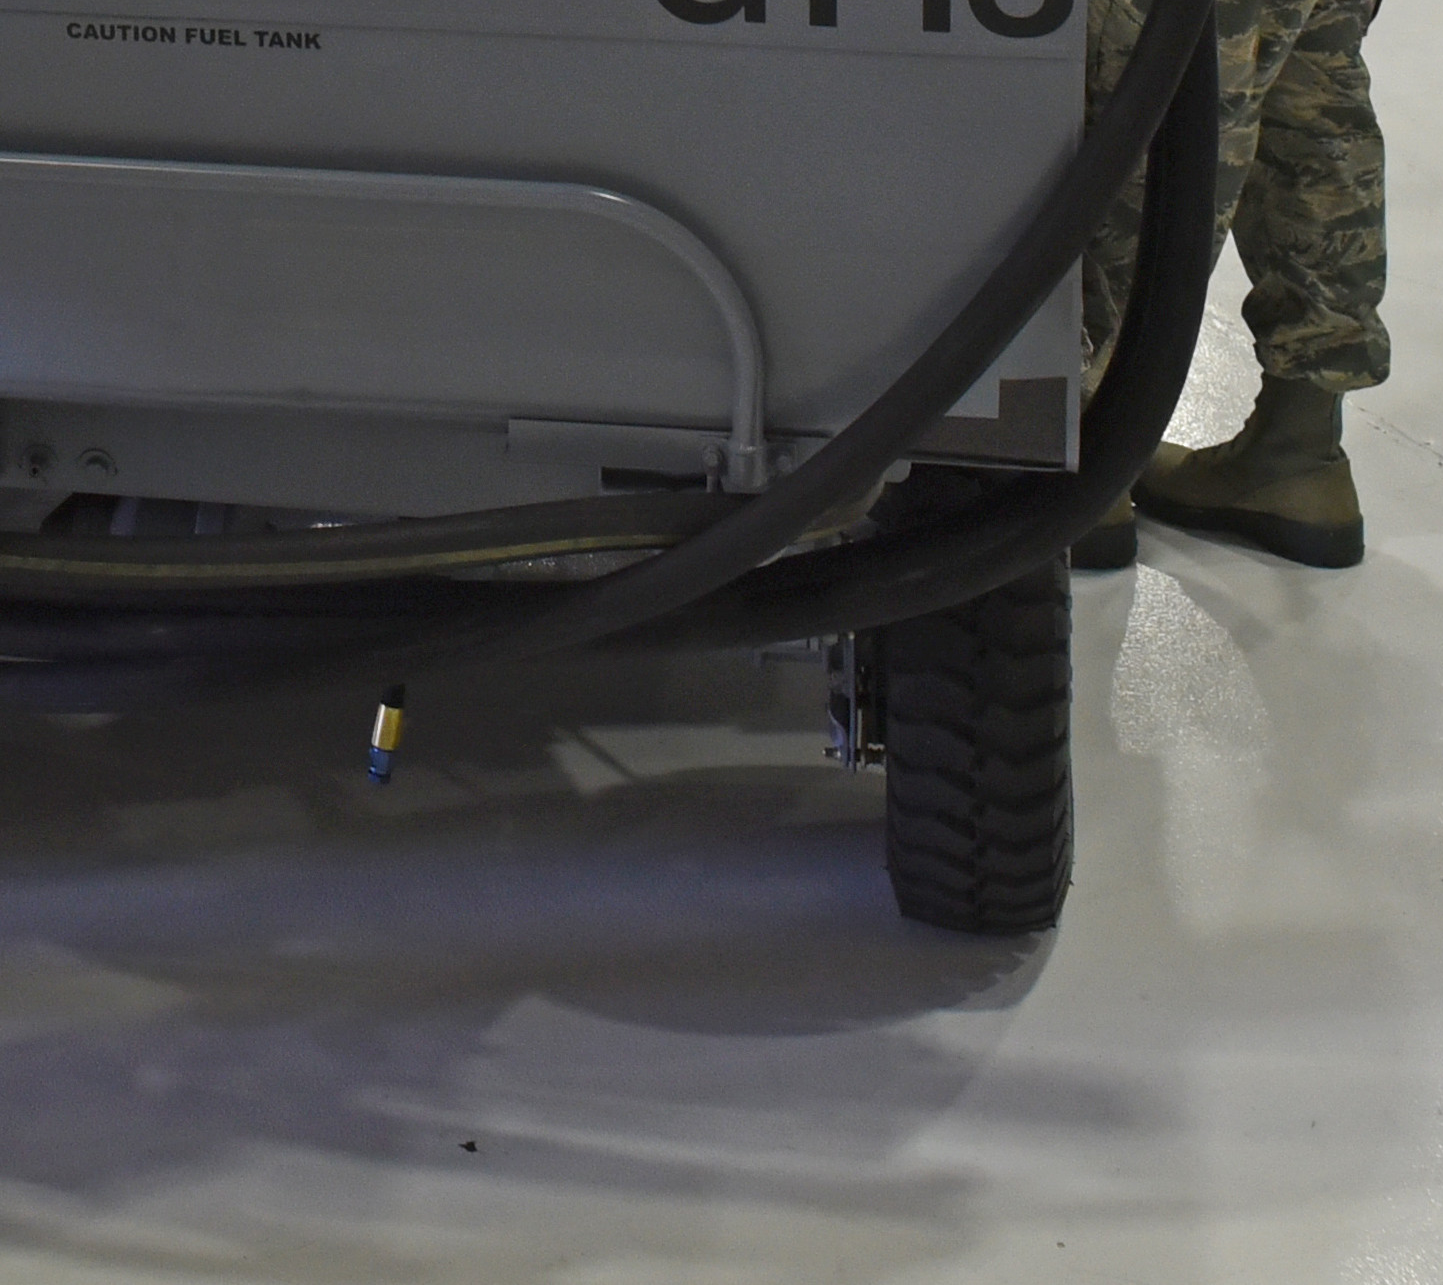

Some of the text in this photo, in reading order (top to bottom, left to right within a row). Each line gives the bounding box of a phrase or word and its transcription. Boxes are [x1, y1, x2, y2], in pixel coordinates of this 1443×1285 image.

[66, 22, 322, 50] CAUTION FUEL TANK
